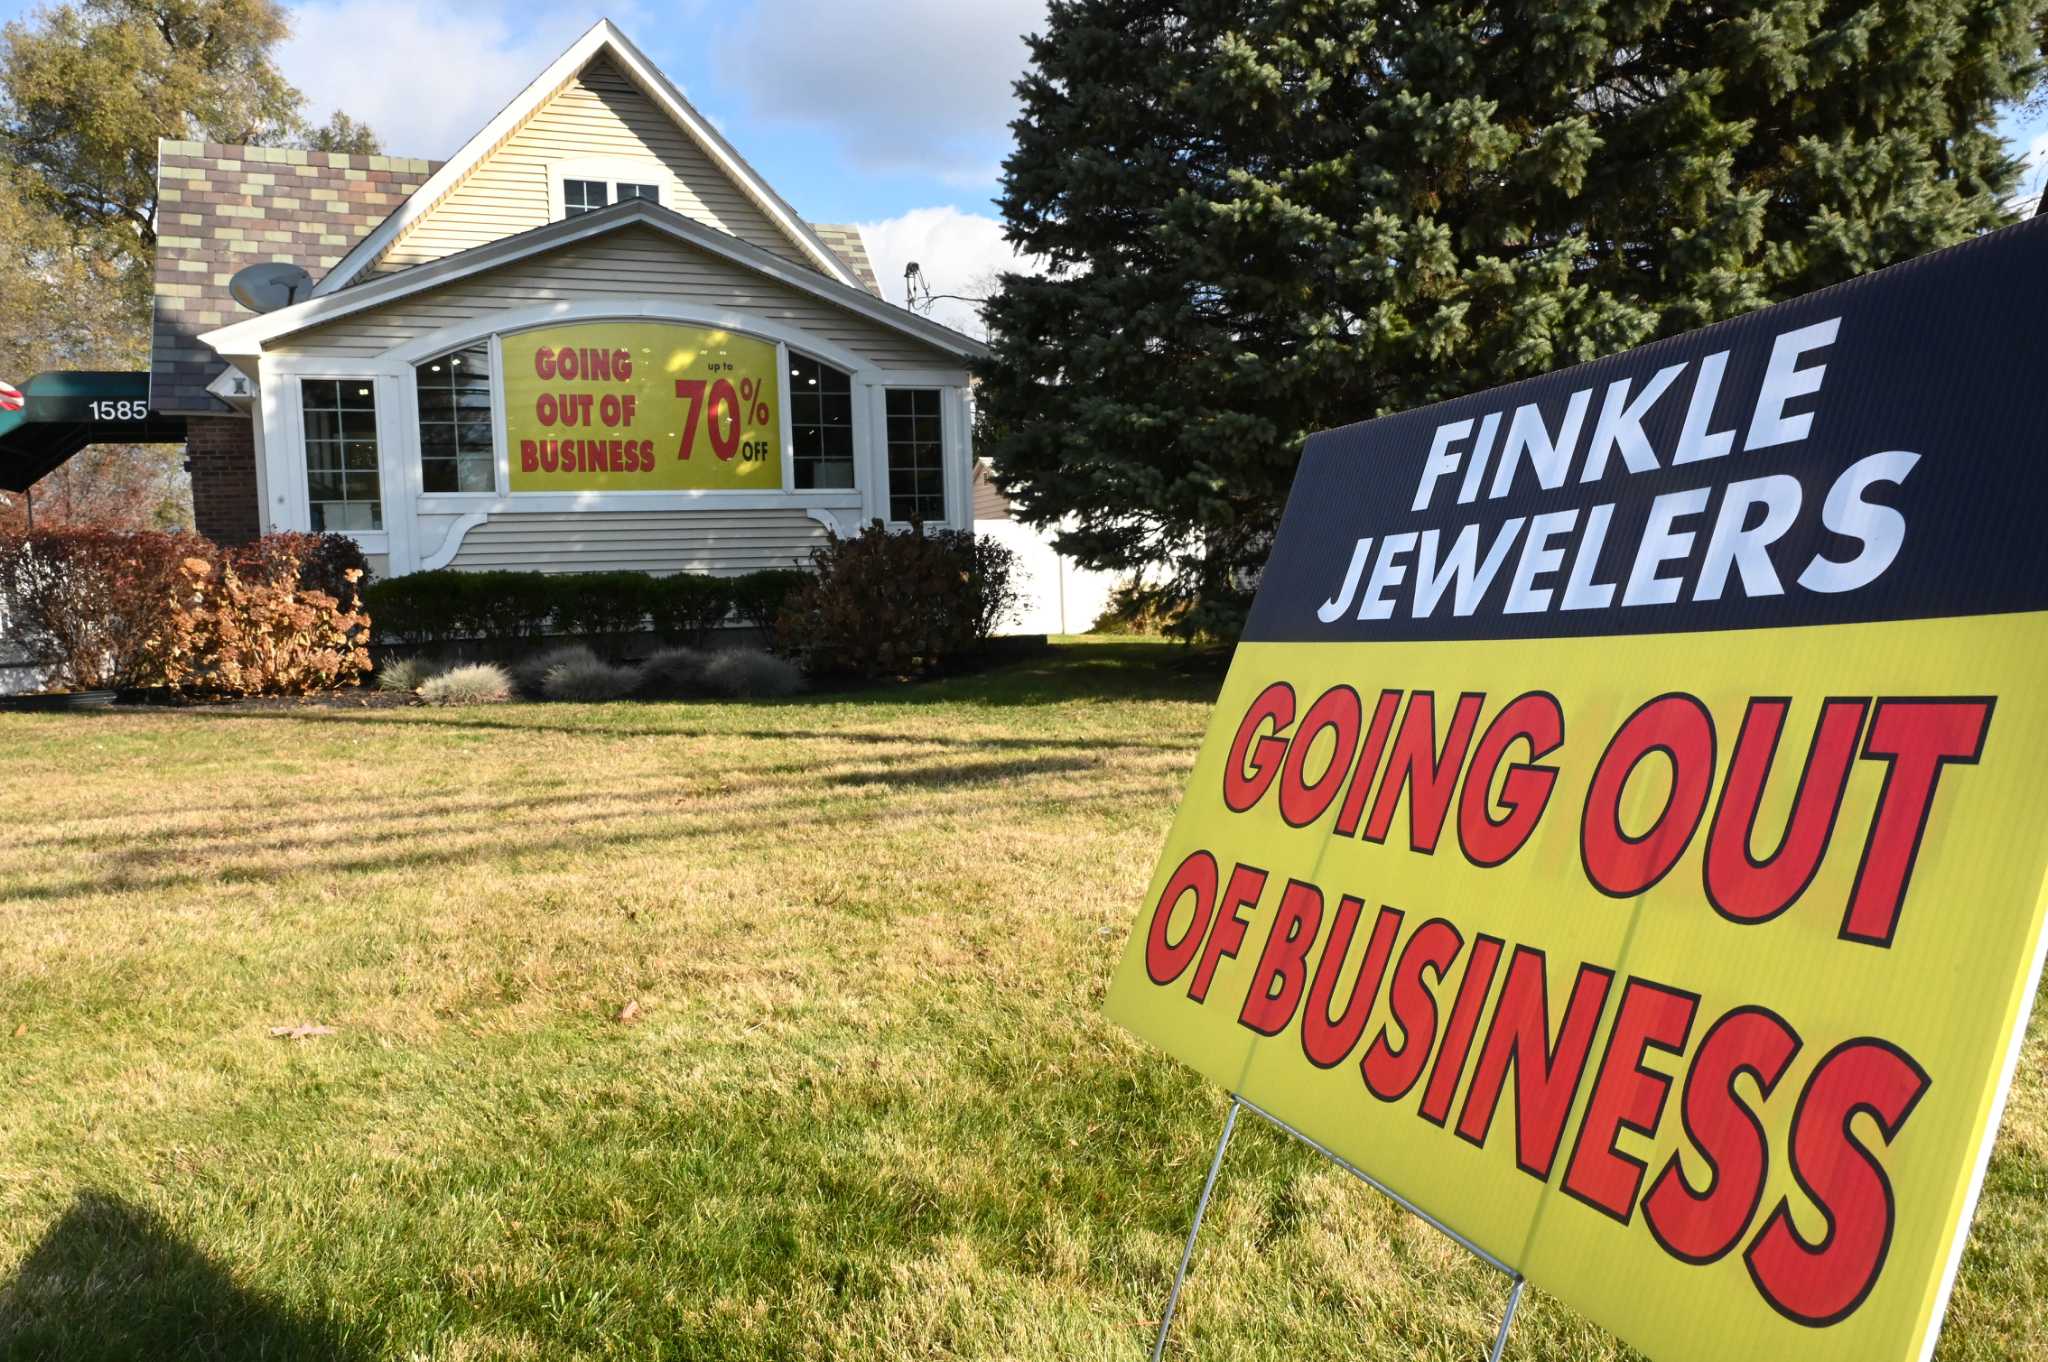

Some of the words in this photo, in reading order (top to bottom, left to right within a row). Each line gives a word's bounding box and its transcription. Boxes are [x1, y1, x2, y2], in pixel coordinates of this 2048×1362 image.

[535, 346, 633, 382] GOING
[708, 363, 720, 372] up
[723, 361, 733, 371] to
[89, 400, 148, 420] 1585
[536, 393, 594, 426] OUT
[600, 393, 636, 426] OF
[1411, 317, 1842, 511] FINKLE
[520, 439, 656, 473] BUSINESS
[742, 441, 768, 462] OFF
[1317, 450, 1922, 624] JEWELERS
[1222, 681, 1565, 868] GOING
[1580, 691, 1998, 949] OUT
[1146, 850, 1268, 1004] OF
[1238, 877, 1932, 1329] BUSINESS
